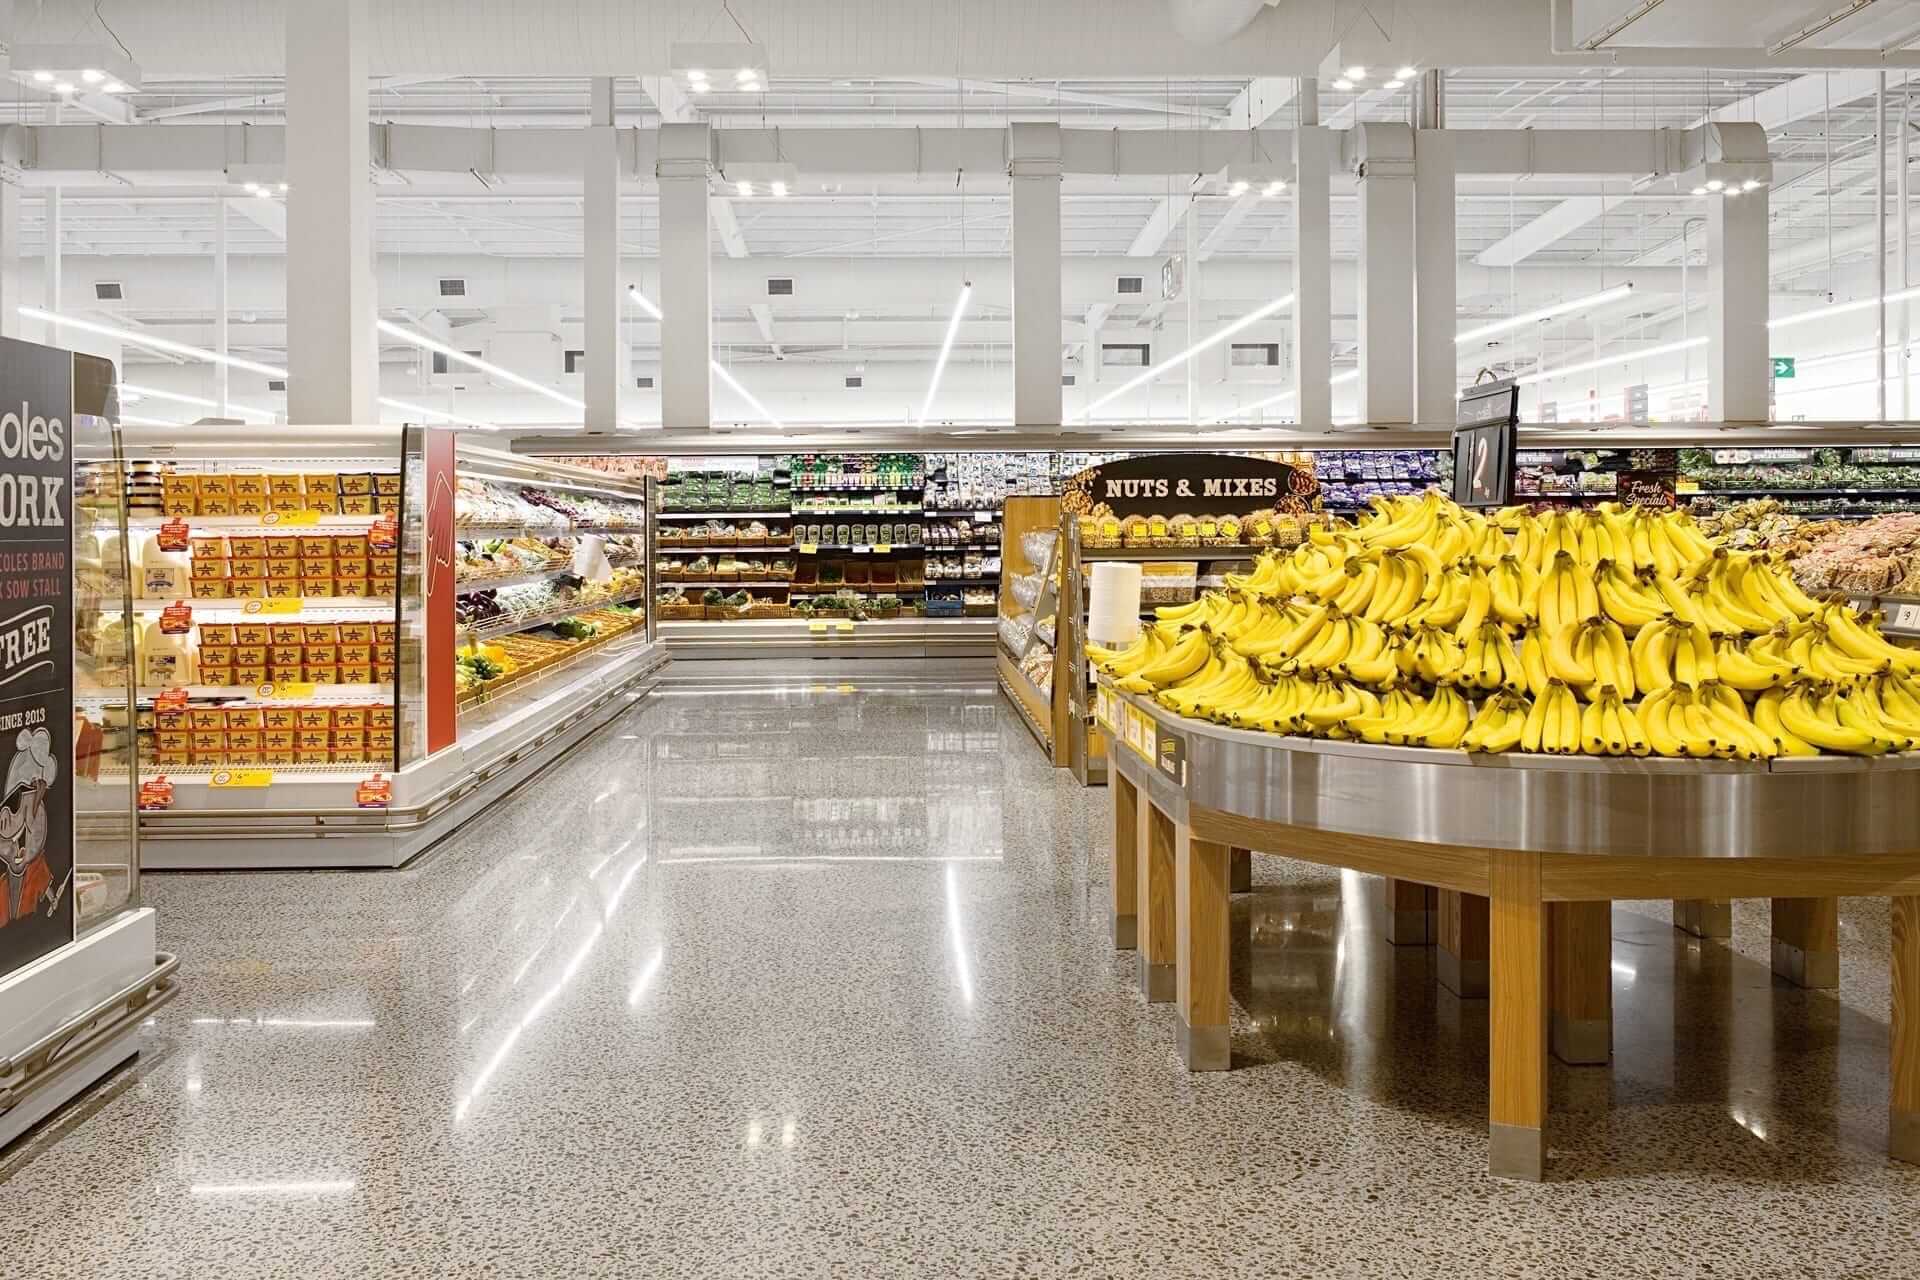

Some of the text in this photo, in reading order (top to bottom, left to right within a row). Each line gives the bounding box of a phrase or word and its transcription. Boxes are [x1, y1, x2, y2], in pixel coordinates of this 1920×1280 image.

[1106, 478, 1277, 498] NUTS & MIXES
[1631, 480, 1662, 494] Fresh
[32, 552, 65, 571] BRAND
[7, 580, 29, 599] SOW
[33, 577, 61, 597] STALL
[0, 707, 46, 731] INCE 2013
